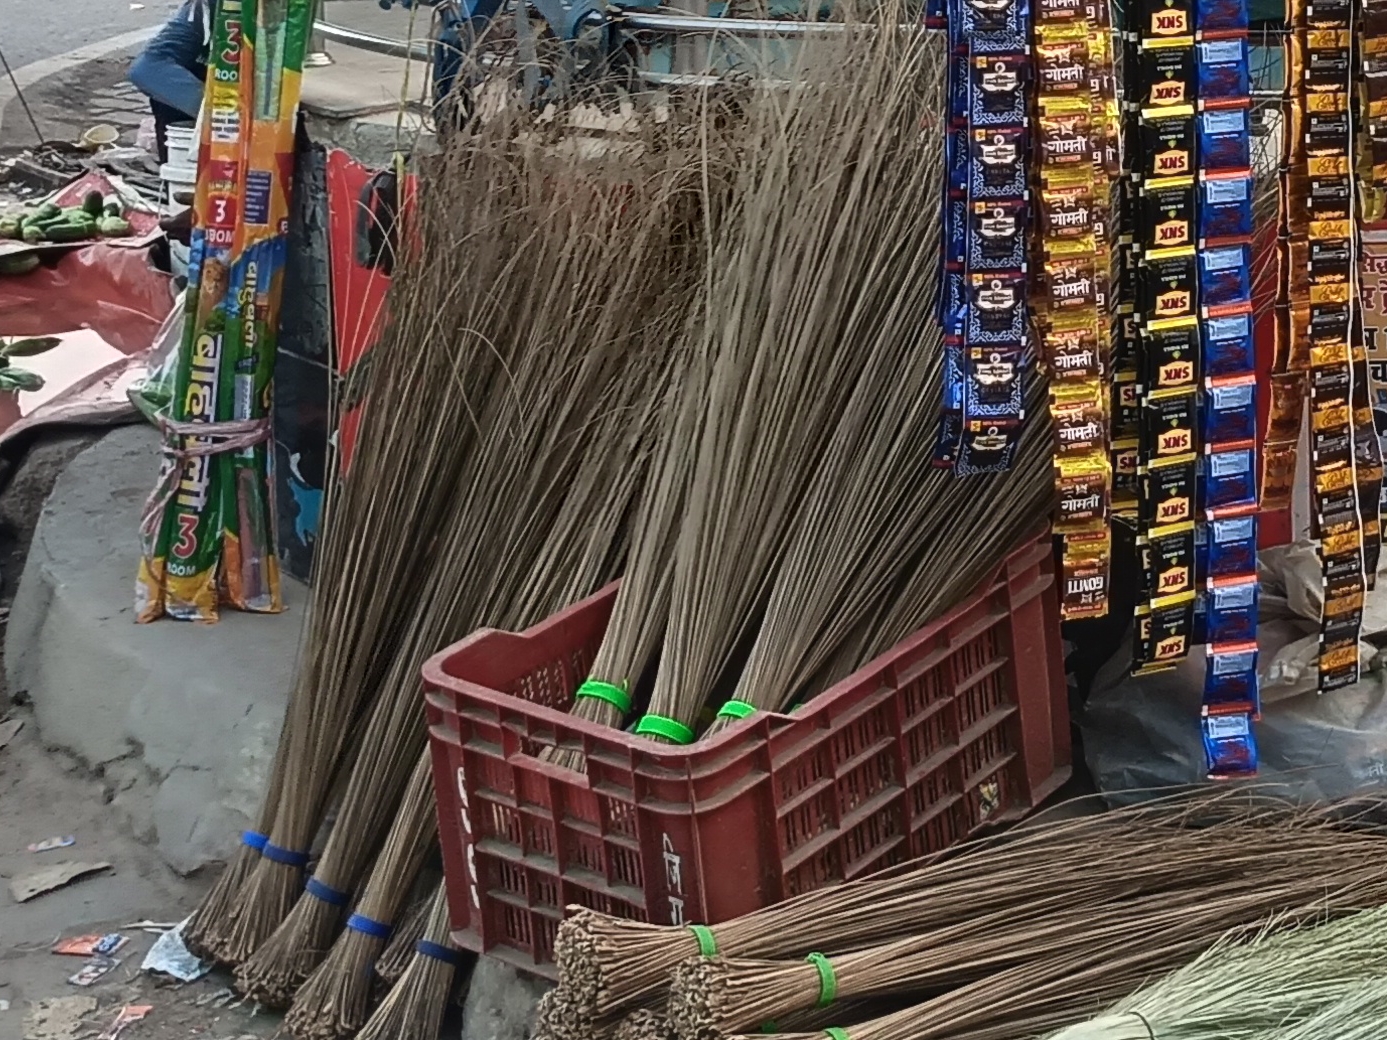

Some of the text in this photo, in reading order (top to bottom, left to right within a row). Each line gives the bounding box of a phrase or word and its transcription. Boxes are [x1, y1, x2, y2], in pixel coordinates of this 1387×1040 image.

[1156, 14, 1184, 29] SNK
[1046, 63, 1084, 81] गोमती
[1154, 85, 1182, 100] SNK
[1047, 135, 1087, 153] गोमती
[1158, 156, 1186, 170] SNK
[214, 198, 227, 224] 3
[1050, 209, 1088, 226] गोमती
[1160, 225, 1186, 241] SNK
[1053, 280, 1091, 297] गोमती
[1161, 295, 1188, 311] SNK
[1055, 351, 1093, 369] गोमती
[1163, 366, 1191, 381] SNK
[1059, 422, 1099, 440] गोमती
[1162, 433, 1189, 449] SNK
[1061, 494, 1100, 511] गोमती
[1161, 501, 1187, 518] SNK
[171, 513, 200, 559] 3
[1162, 571, 1187, 588] SNK
[1160, 640, 1184, 656] SNK
